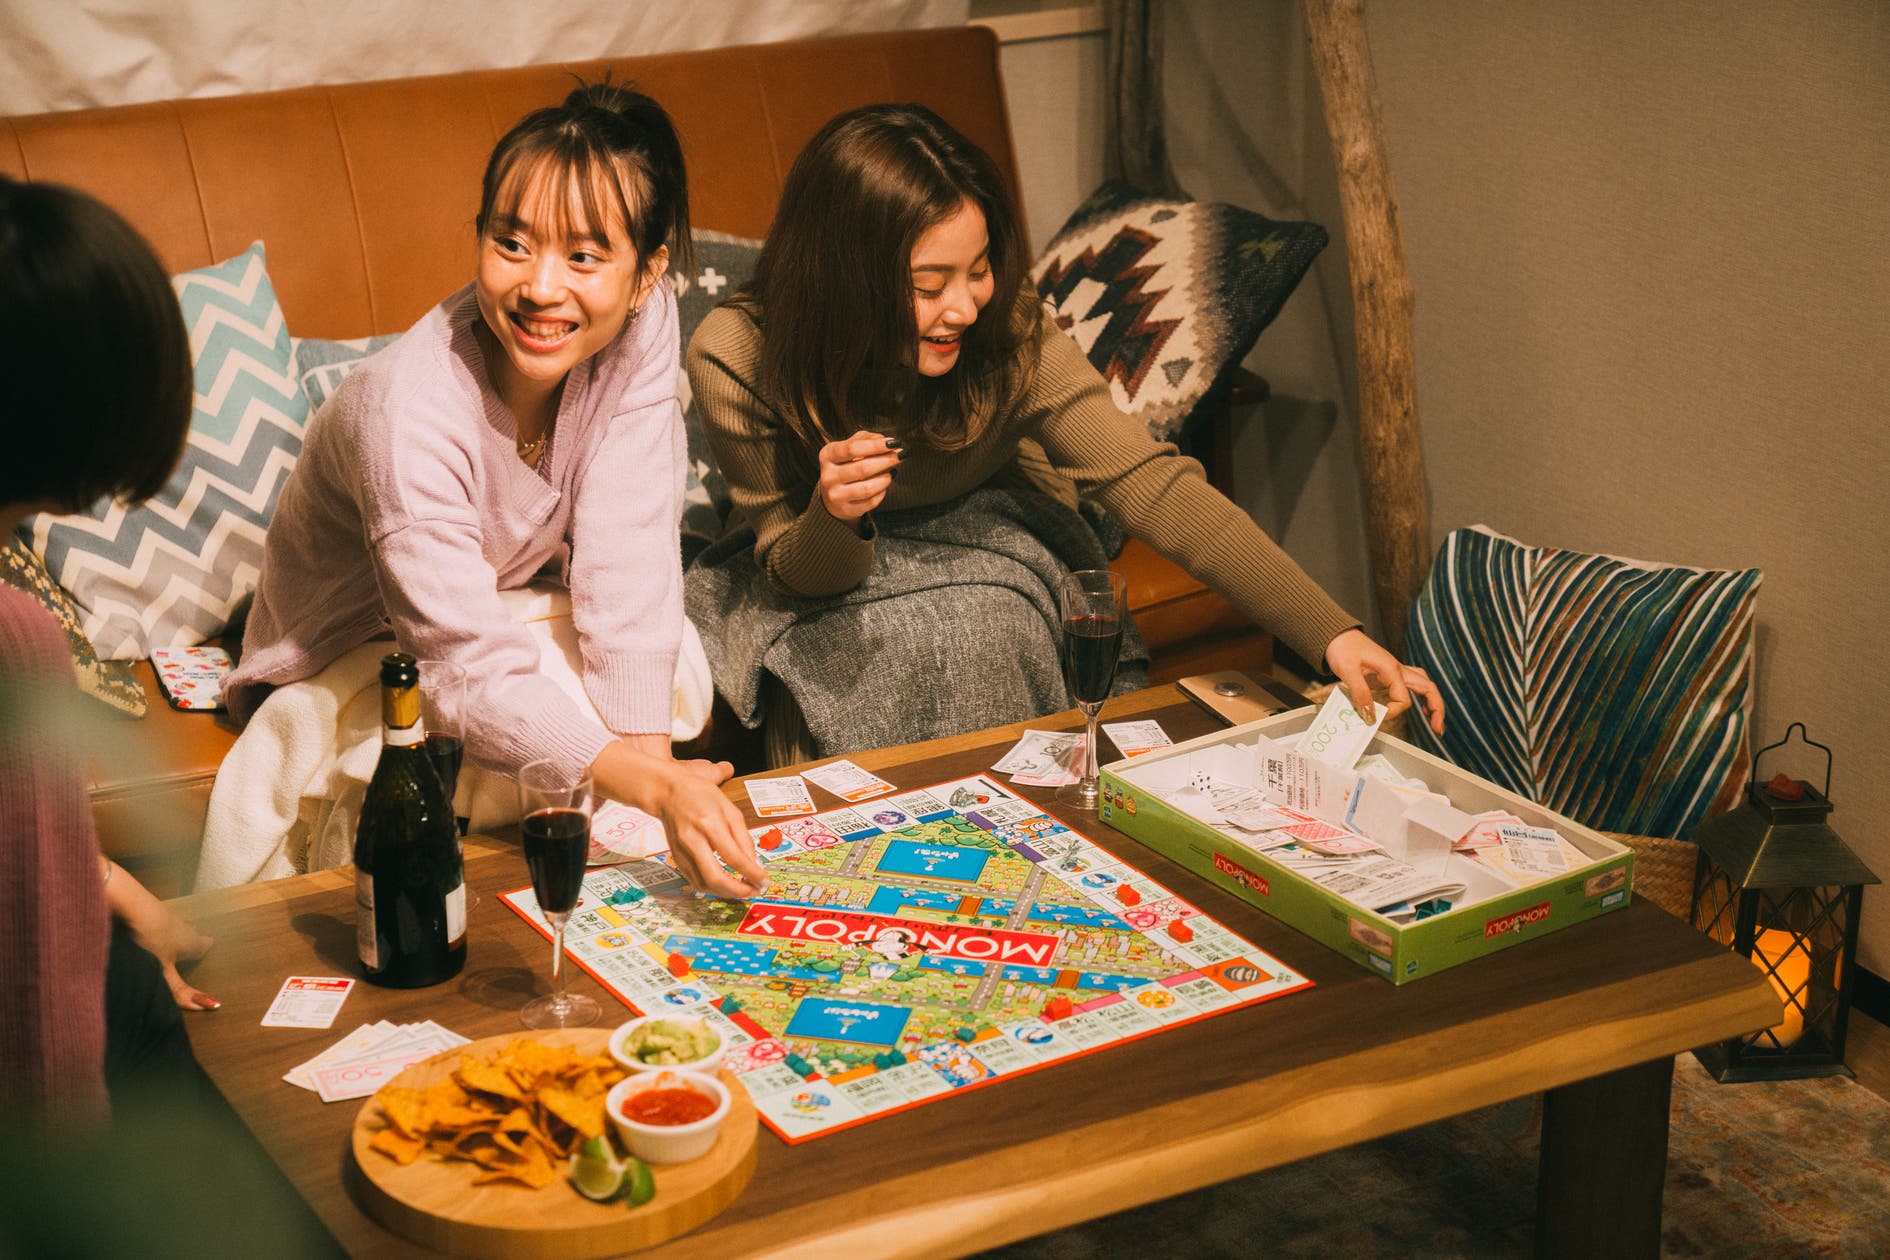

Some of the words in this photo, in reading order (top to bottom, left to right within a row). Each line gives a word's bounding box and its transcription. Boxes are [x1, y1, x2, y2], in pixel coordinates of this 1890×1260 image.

[1268, 758, 1277, 788] 千葉
[832, 821, 871, 834] 梅田
[1215, 858, 1269, 895] MONOPOLY
[1487, 906, 1550, 937] MONOPOLY
[749, 914, 1049, 964] MONOPOLY
